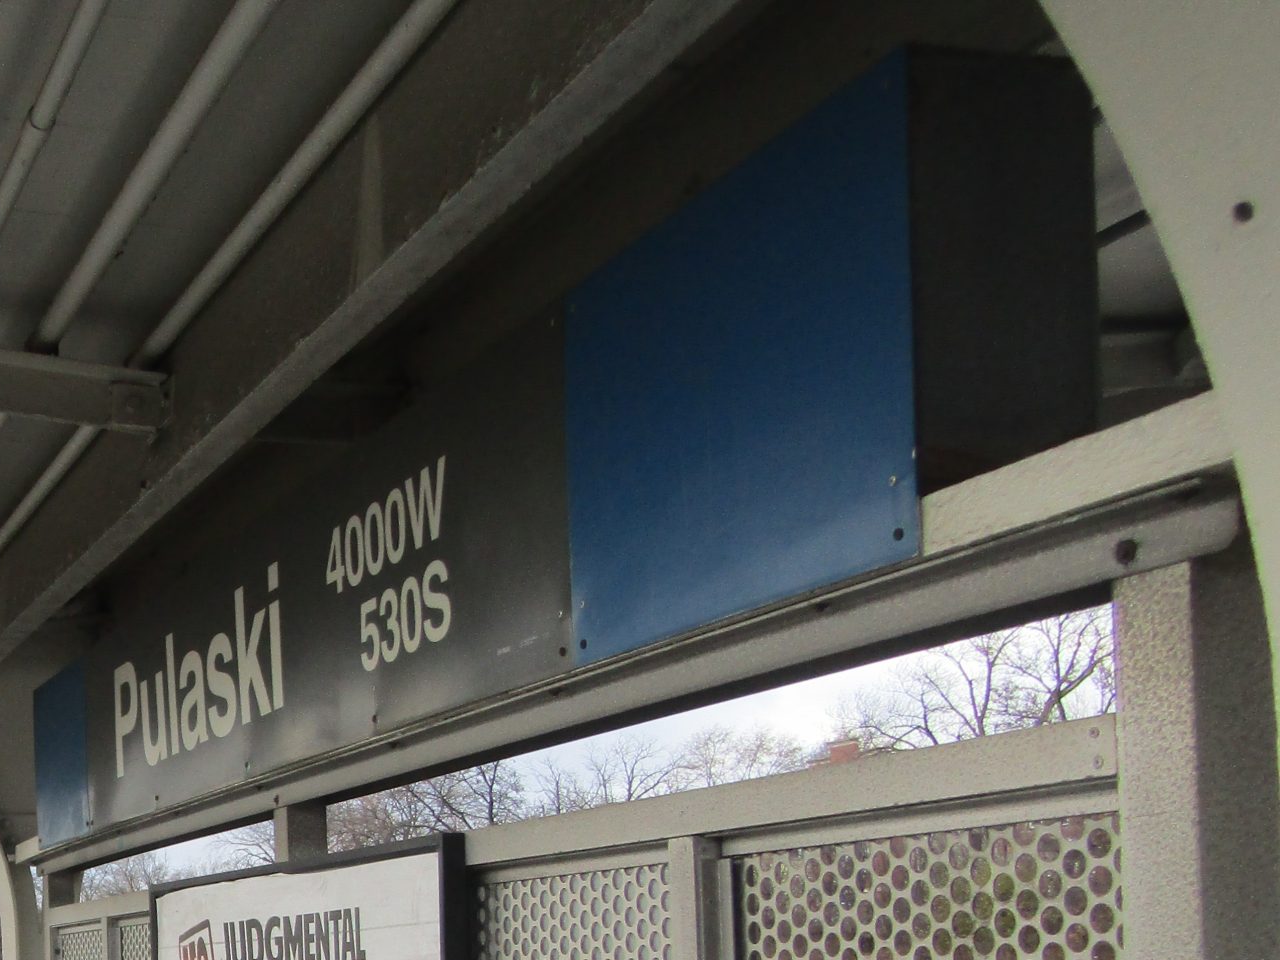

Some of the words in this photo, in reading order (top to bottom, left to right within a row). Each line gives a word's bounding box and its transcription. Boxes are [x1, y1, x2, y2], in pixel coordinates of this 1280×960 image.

[325, 455, 447, 594] 4000W
[114, 561, 285, 778] Pulaski
[359, 559, 452, 672] 530S
